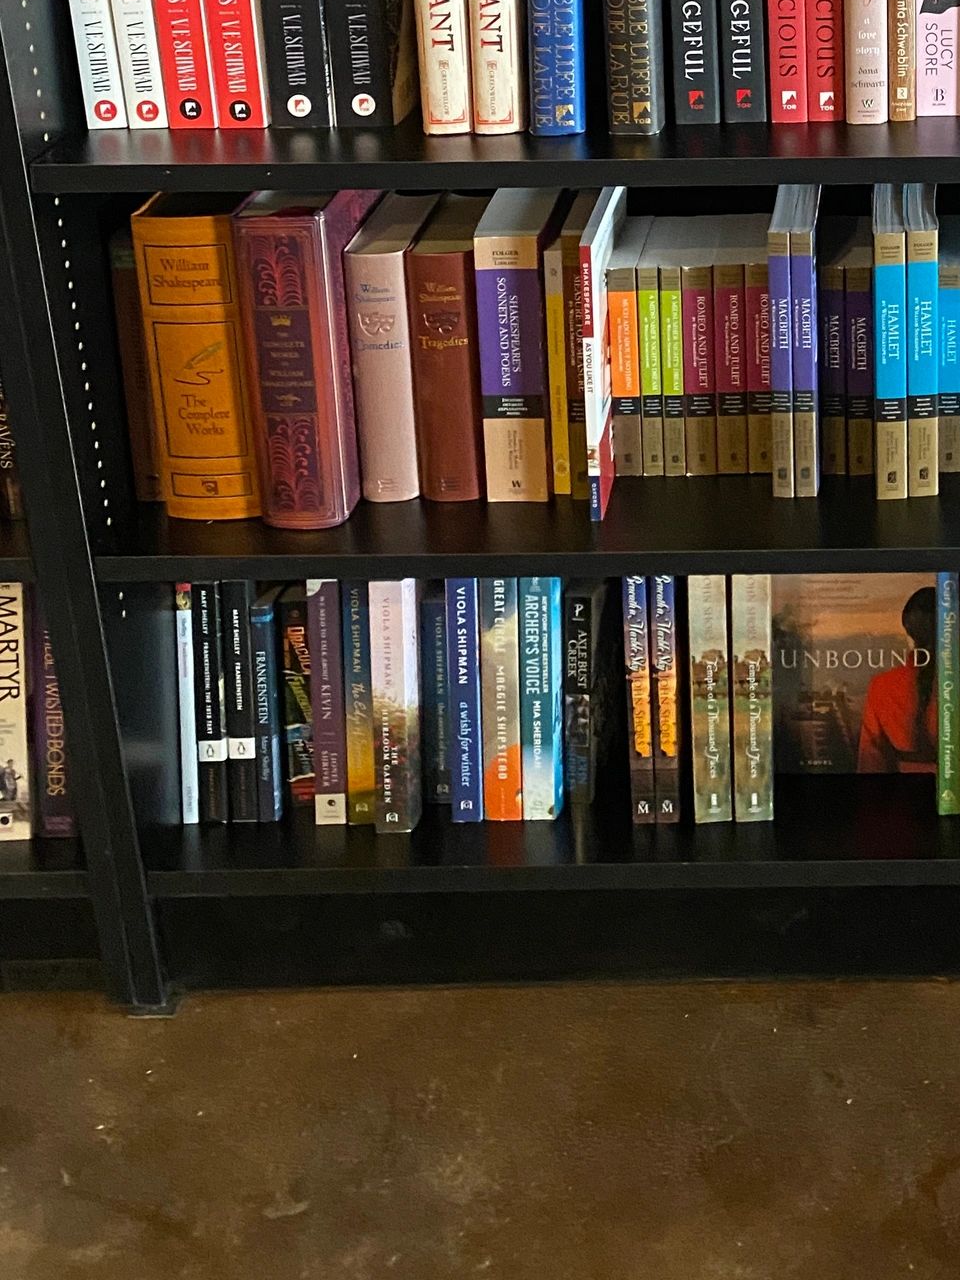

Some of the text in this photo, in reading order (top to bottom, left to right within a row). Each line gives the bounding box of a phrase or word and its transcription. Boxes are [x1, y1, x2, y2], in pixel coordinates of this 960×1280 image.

[925, 23, 938, 76] SCORE
[939, 29, 952, 69] LUCY
[154, 275, 223, 289] Shakespeare
[160, 257, 209, 272] William
[582, 263, 590, 325] SHAKESPEARE
[802, 298, 811, 349] MACBETH
[887, 304, 899, 360] HAMLET
[181, 395, 205, 407] The
[186, 423, 225, 435] Works
[456, 587, 468, 684] VIOLA SHIPMAN
[525, 595, 540, 695] ARCHER'S VOICE
[780, 648, 931, 668] UNBOUND
[257, 651, 268, 724] FRANKENSTEIN
